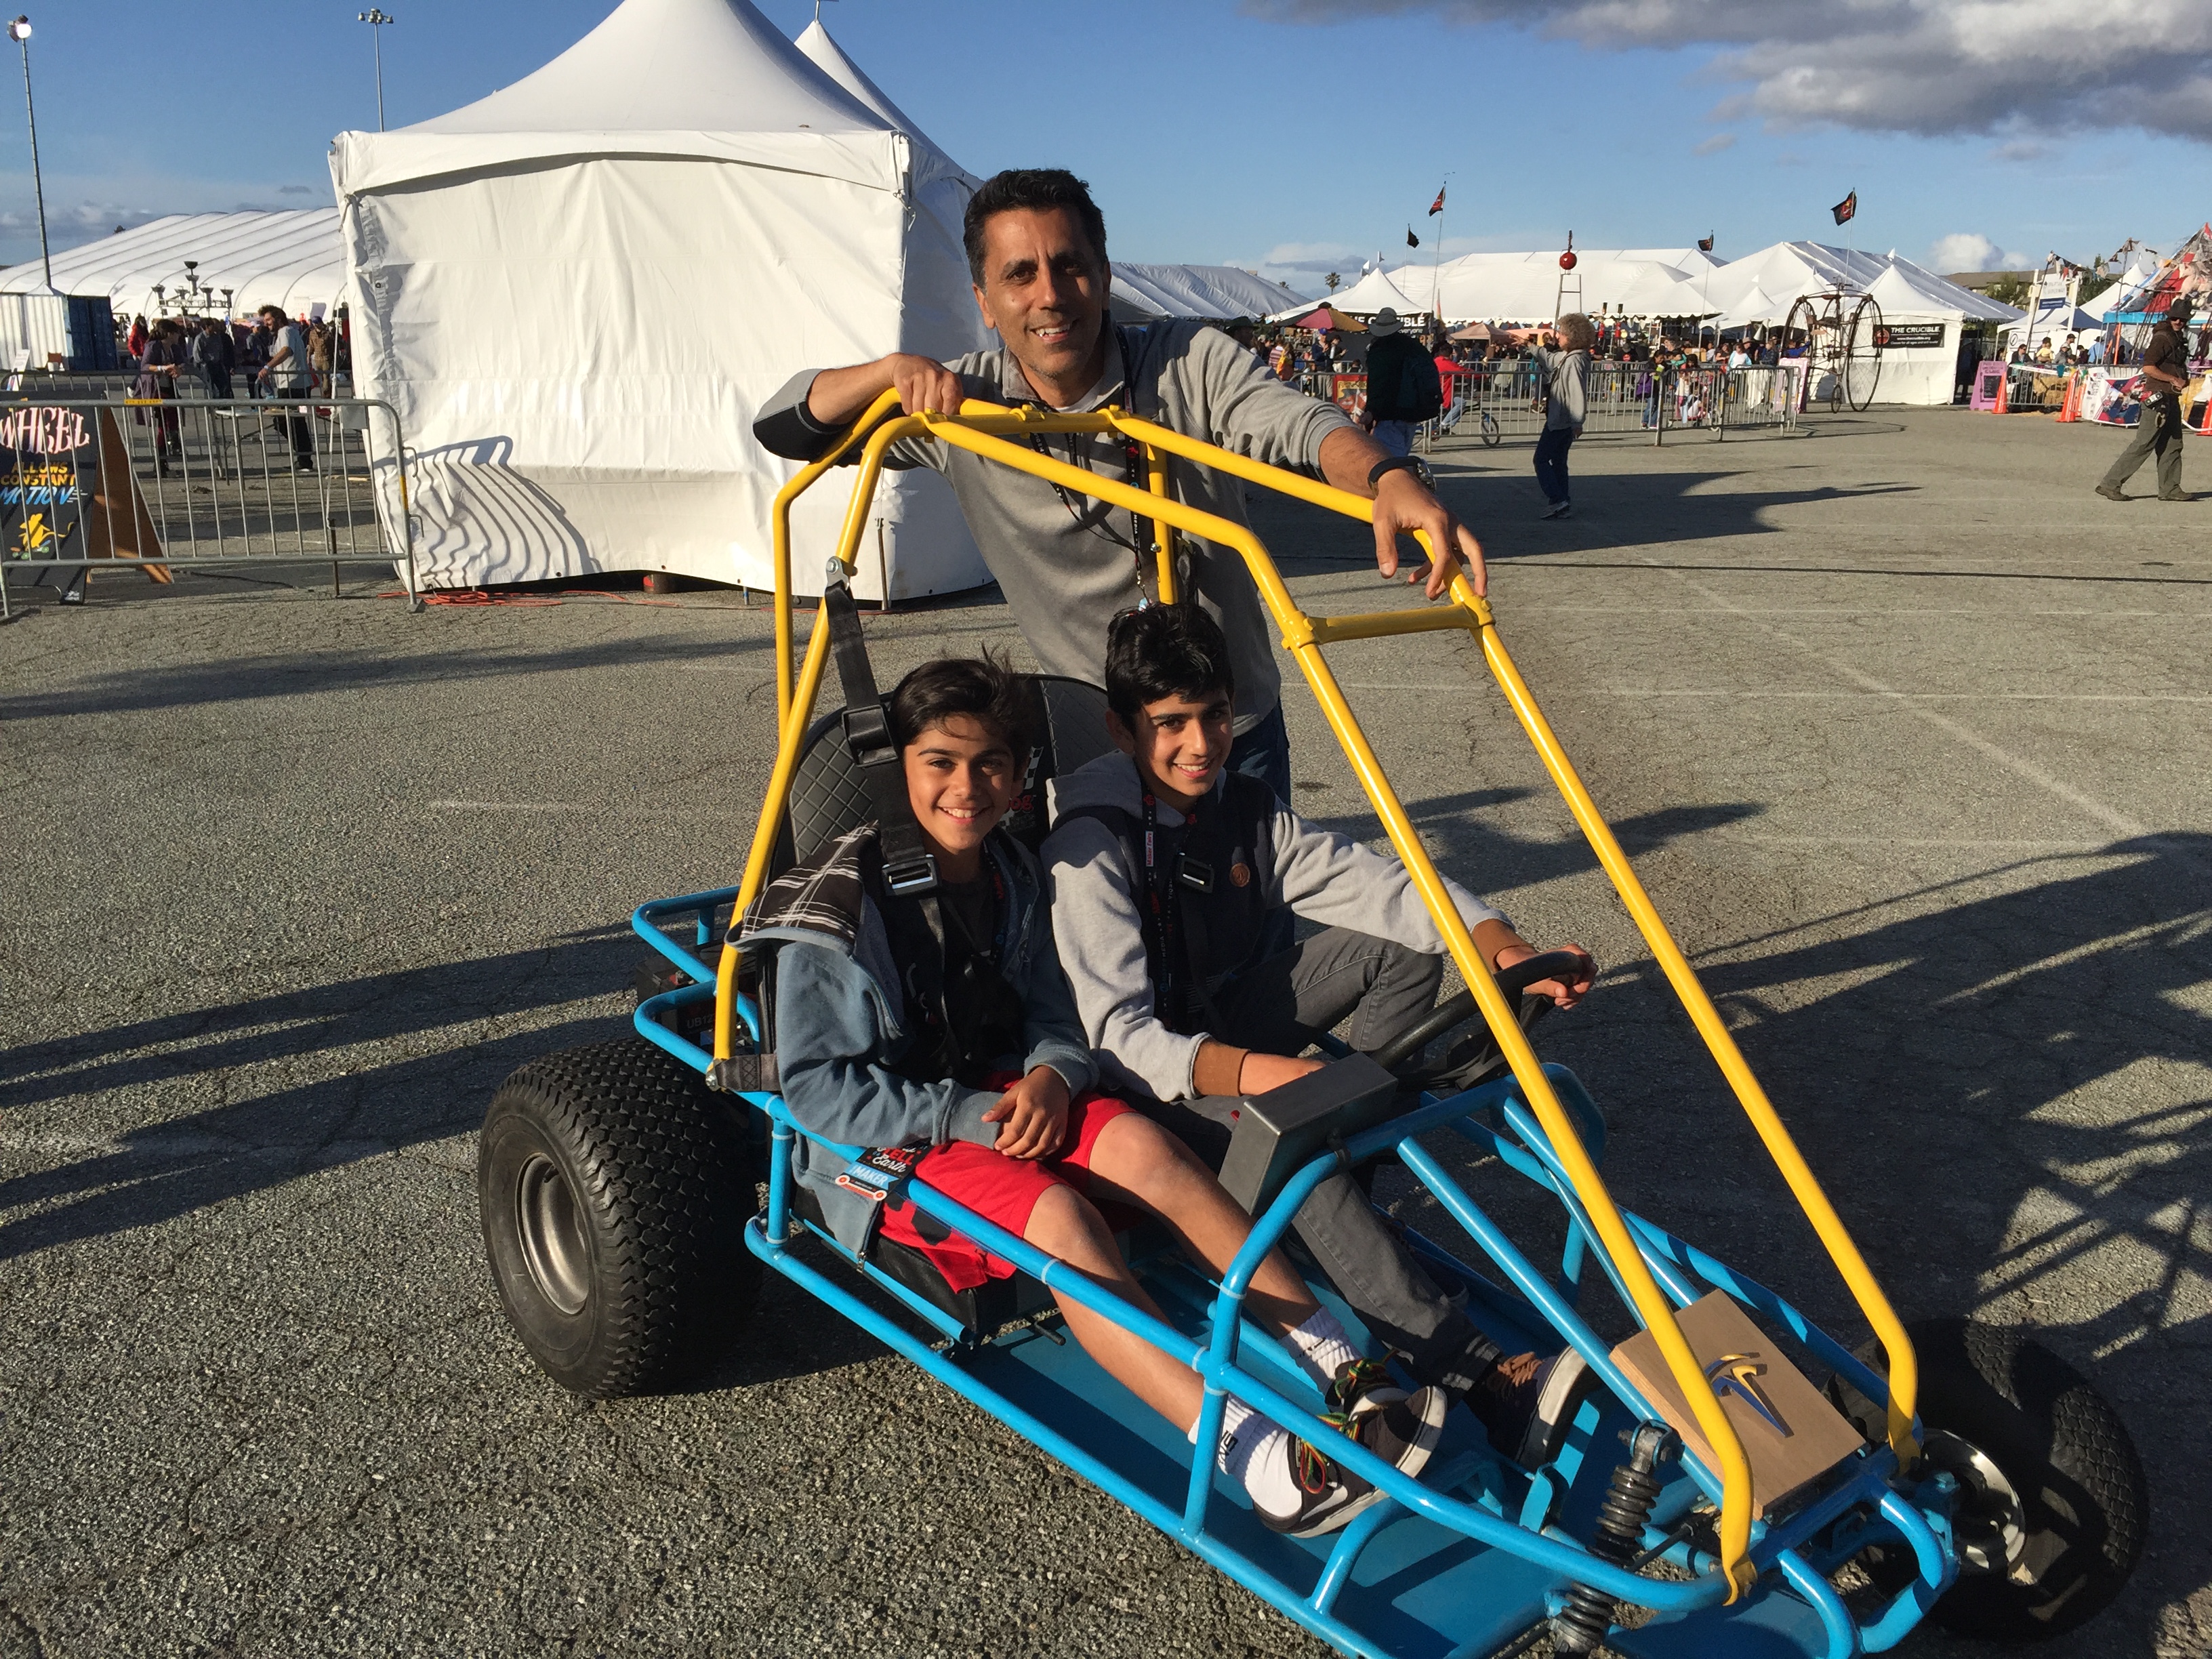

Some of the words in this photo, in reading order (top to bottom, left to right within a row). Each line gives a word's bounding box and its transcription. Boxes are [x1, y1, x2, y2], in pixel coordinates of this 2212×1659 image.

[0, 407, 90, 455] WHEEL
[12, 462, 68, 474] ALLOWS
[0, 474, 76, 486] CONSTANT
[0, 486, 76, 505] MOTION
[872, 1153, 907, 1172] Earth
[854, 1165, 888, 1185] MAKER
